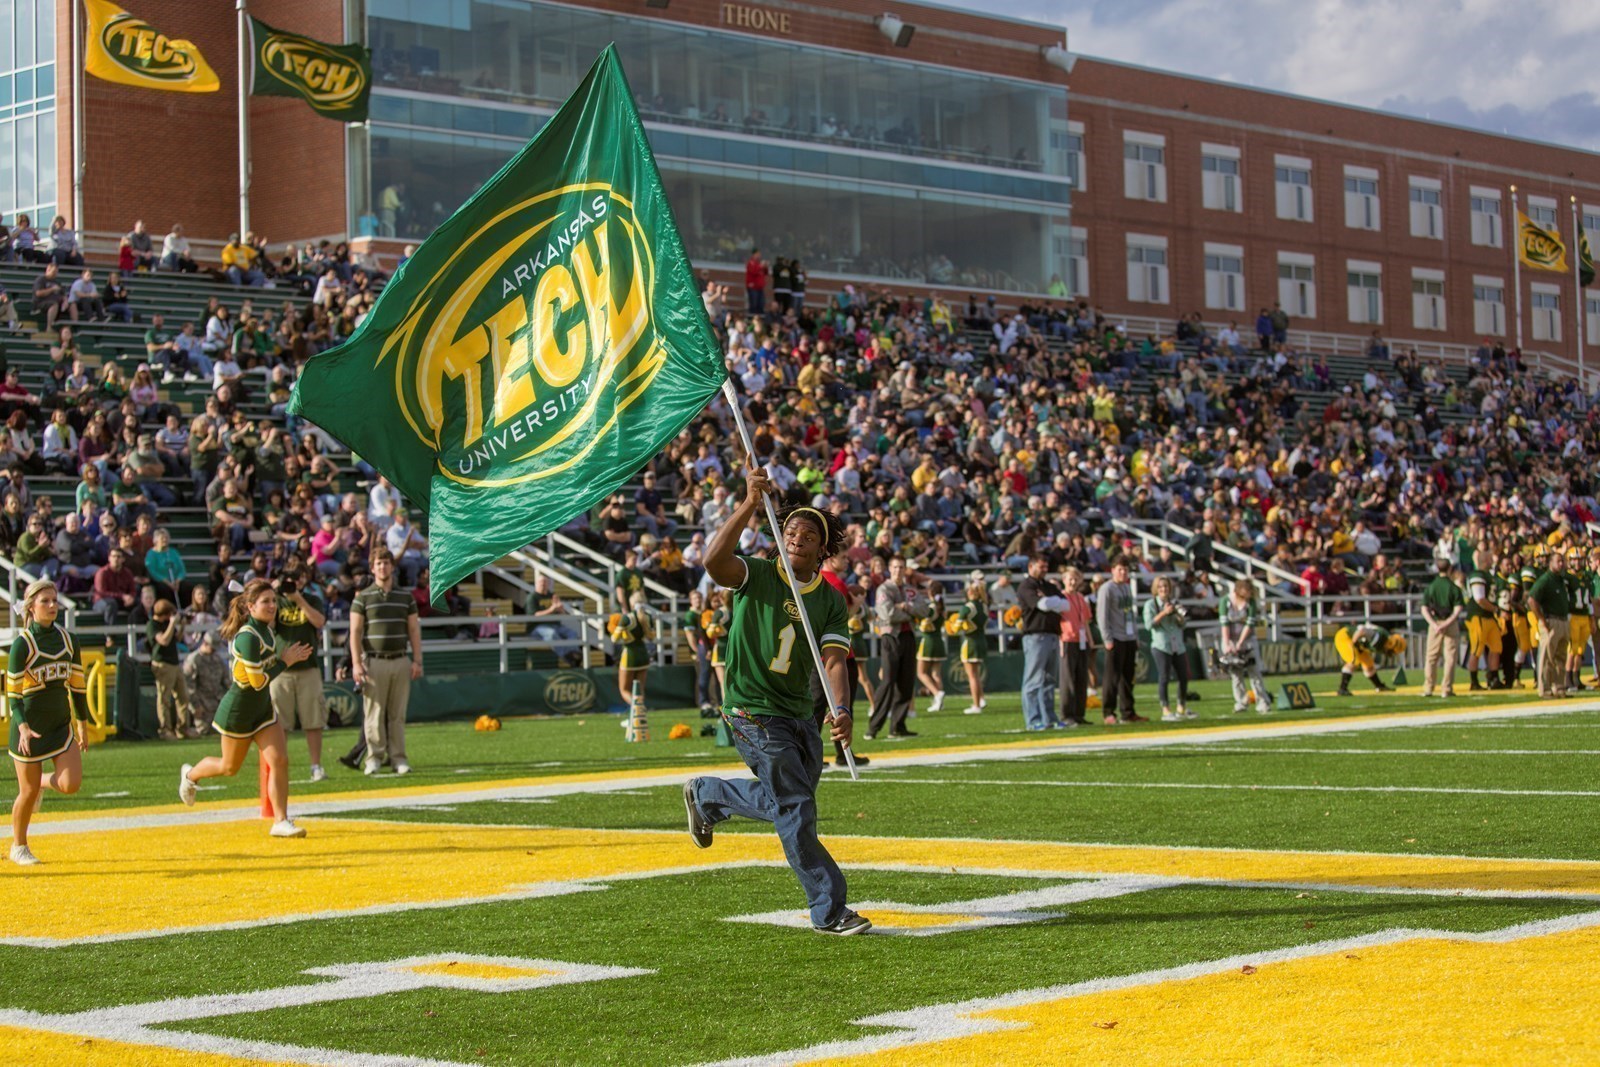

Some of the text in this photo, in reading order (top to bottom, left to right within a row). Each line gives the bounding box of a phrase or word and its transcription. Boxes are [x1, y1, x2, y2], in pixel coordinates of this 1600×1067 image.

[723, 3, 791, 33] THONE
[278, 44, 352, 94] TECH
[502, 194, 607, 299] ARKANSAS
[441, 219, 648, 449] TECH
[459, 373, 592, 475] UNIVERSITY
[769, 622, 797, 675] 1
[1262, 640, 1341, 673] WELCOM
[550, 681, 589, 703] TECH
[1287, 684, 1311, 706] 20
